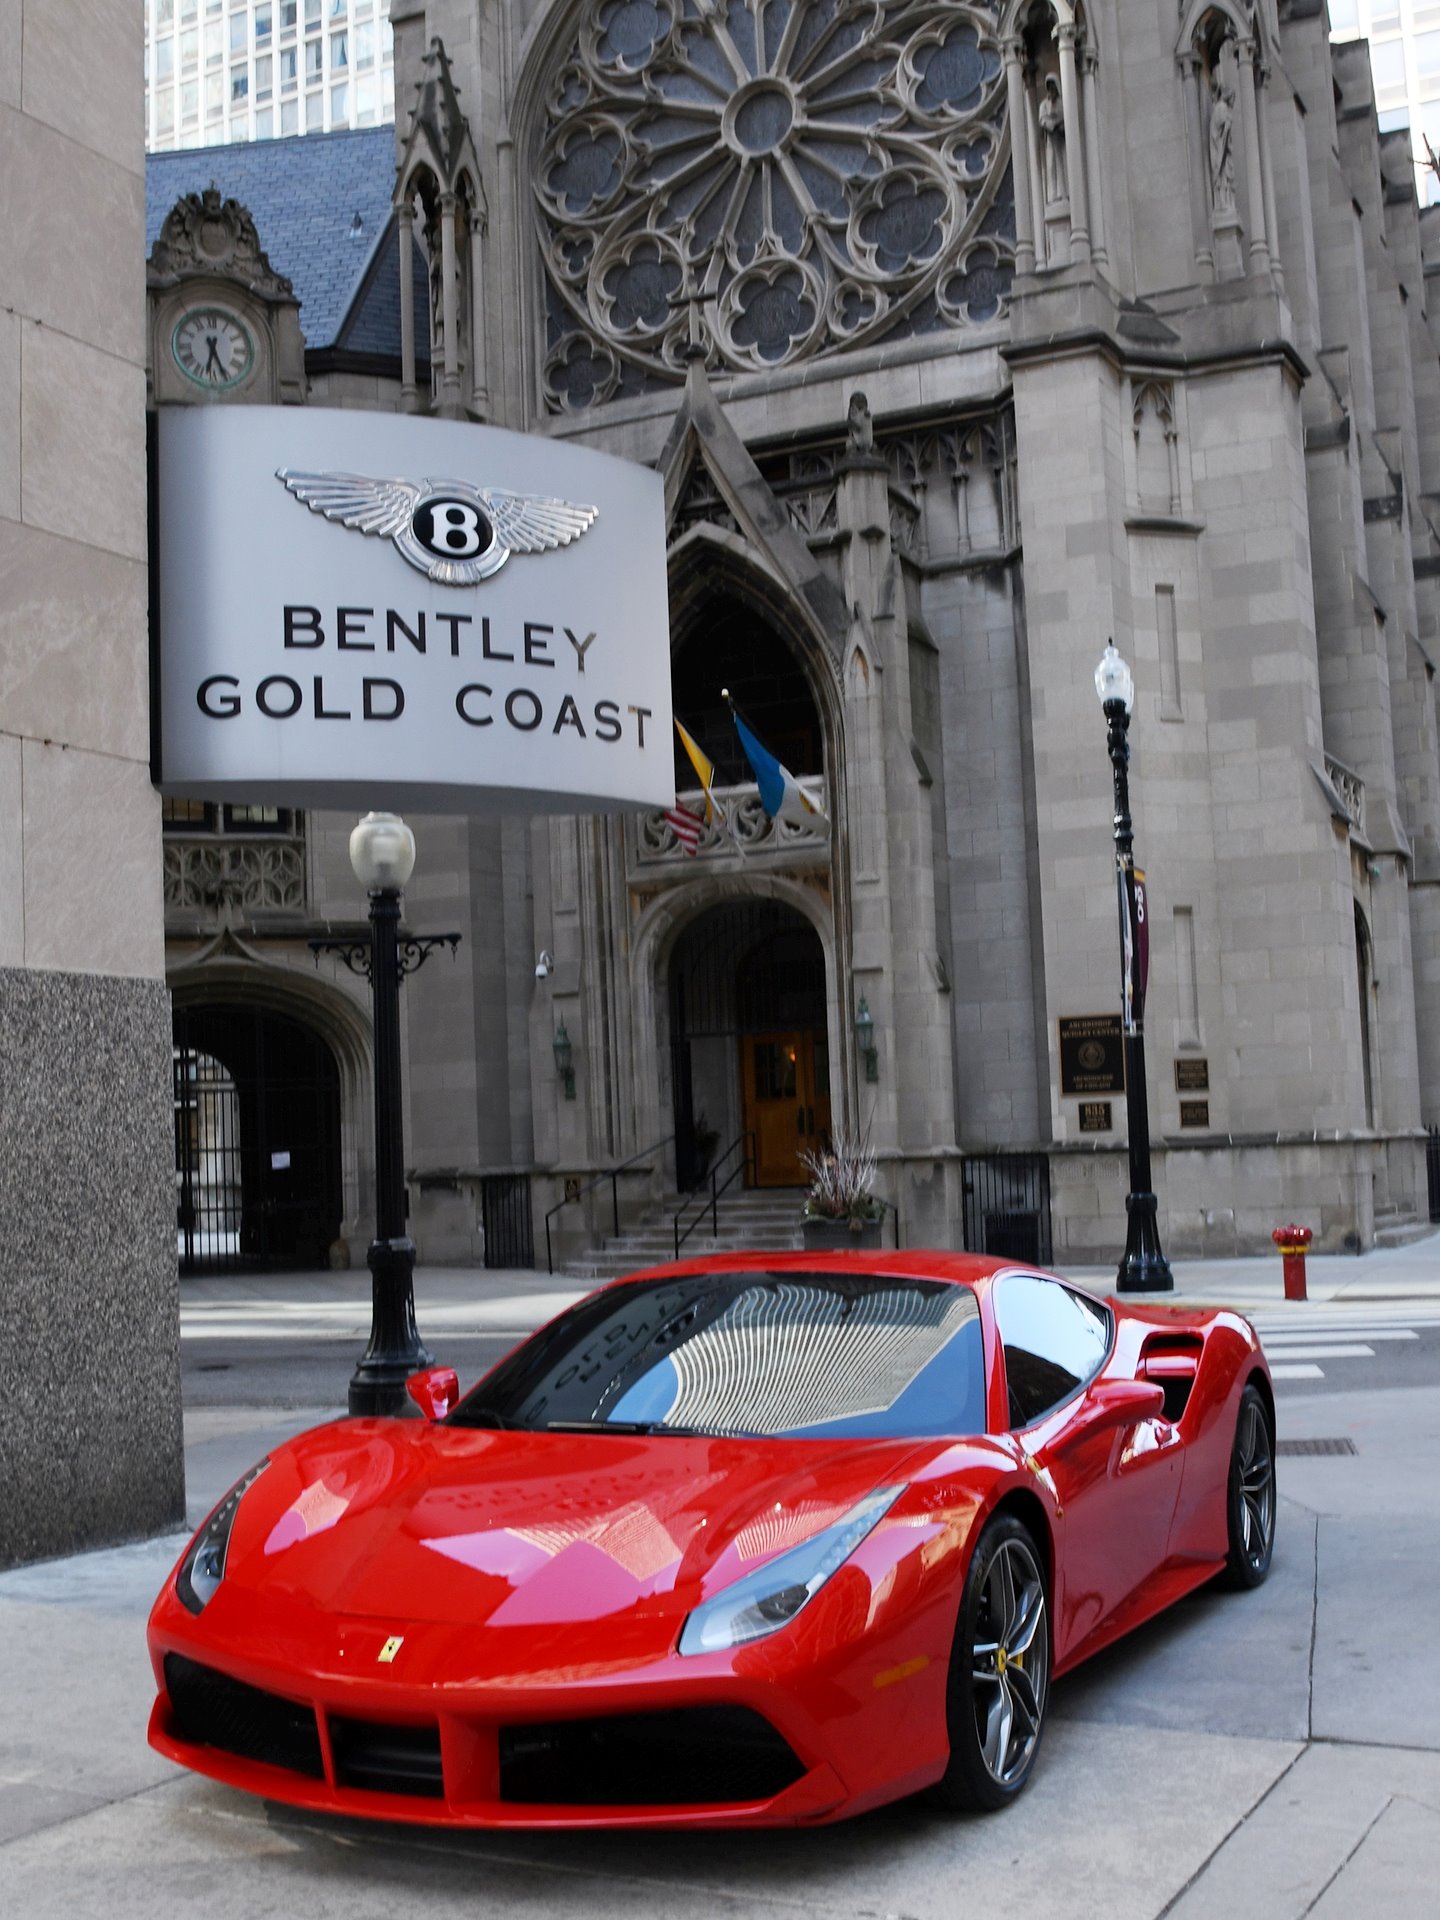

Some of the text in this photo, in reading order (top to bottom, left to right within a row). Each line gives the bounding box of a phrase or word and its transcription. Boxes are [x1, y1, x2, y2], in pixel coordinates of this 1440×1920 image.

[430, 502, 480, 554] B
[283, 605, 597, 673] BENTLEY
[196, 673, 652, 749] GOLD COAST
